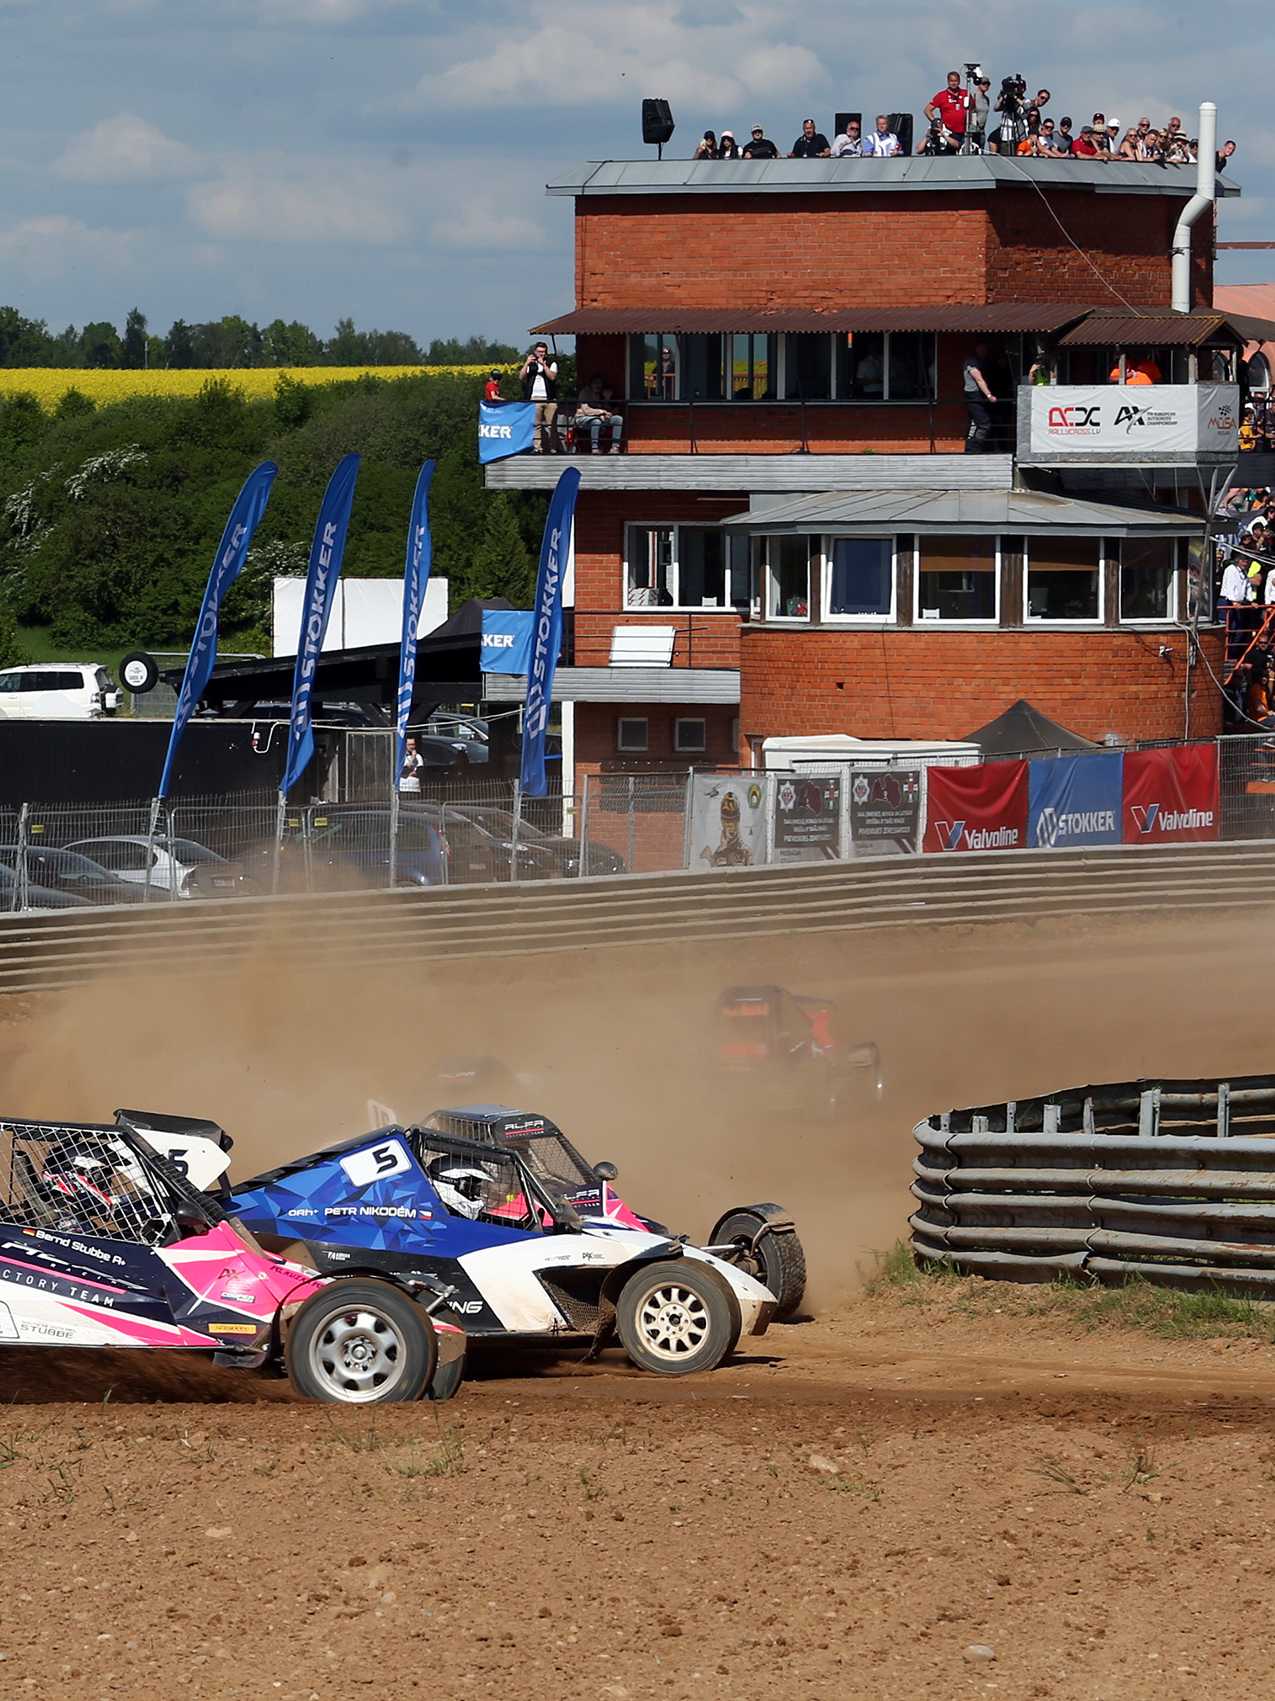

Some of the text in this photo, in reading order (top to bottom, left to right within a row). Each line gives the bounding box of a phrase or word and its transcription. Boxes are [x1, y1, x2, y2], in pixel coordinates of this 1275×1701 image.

[479, 424, 512, 438] KER
[300, 521, 338, 679] STOKKER
[532, 527, 563, 675] STOKKER
[481, 633, 514, 647] KER
[1058, 810, 1115, 835] STOKKER
[1158, 808, 1214, 831] Valvoline
[964, 827, 1018, 850] Valvoline
[373, 1146, 398, 1174] 5
[324, 1207, 357, 1216] PETR
[359, 1206, 416, 1219] NIKODÉM
[35, 1230, 70, 1247] Bernd
[71, 1240, 111, 1262] Stubbe
[70, 1286, 116, 1307] TEAM
[20, 1324, 74, 1339] STUBBE
